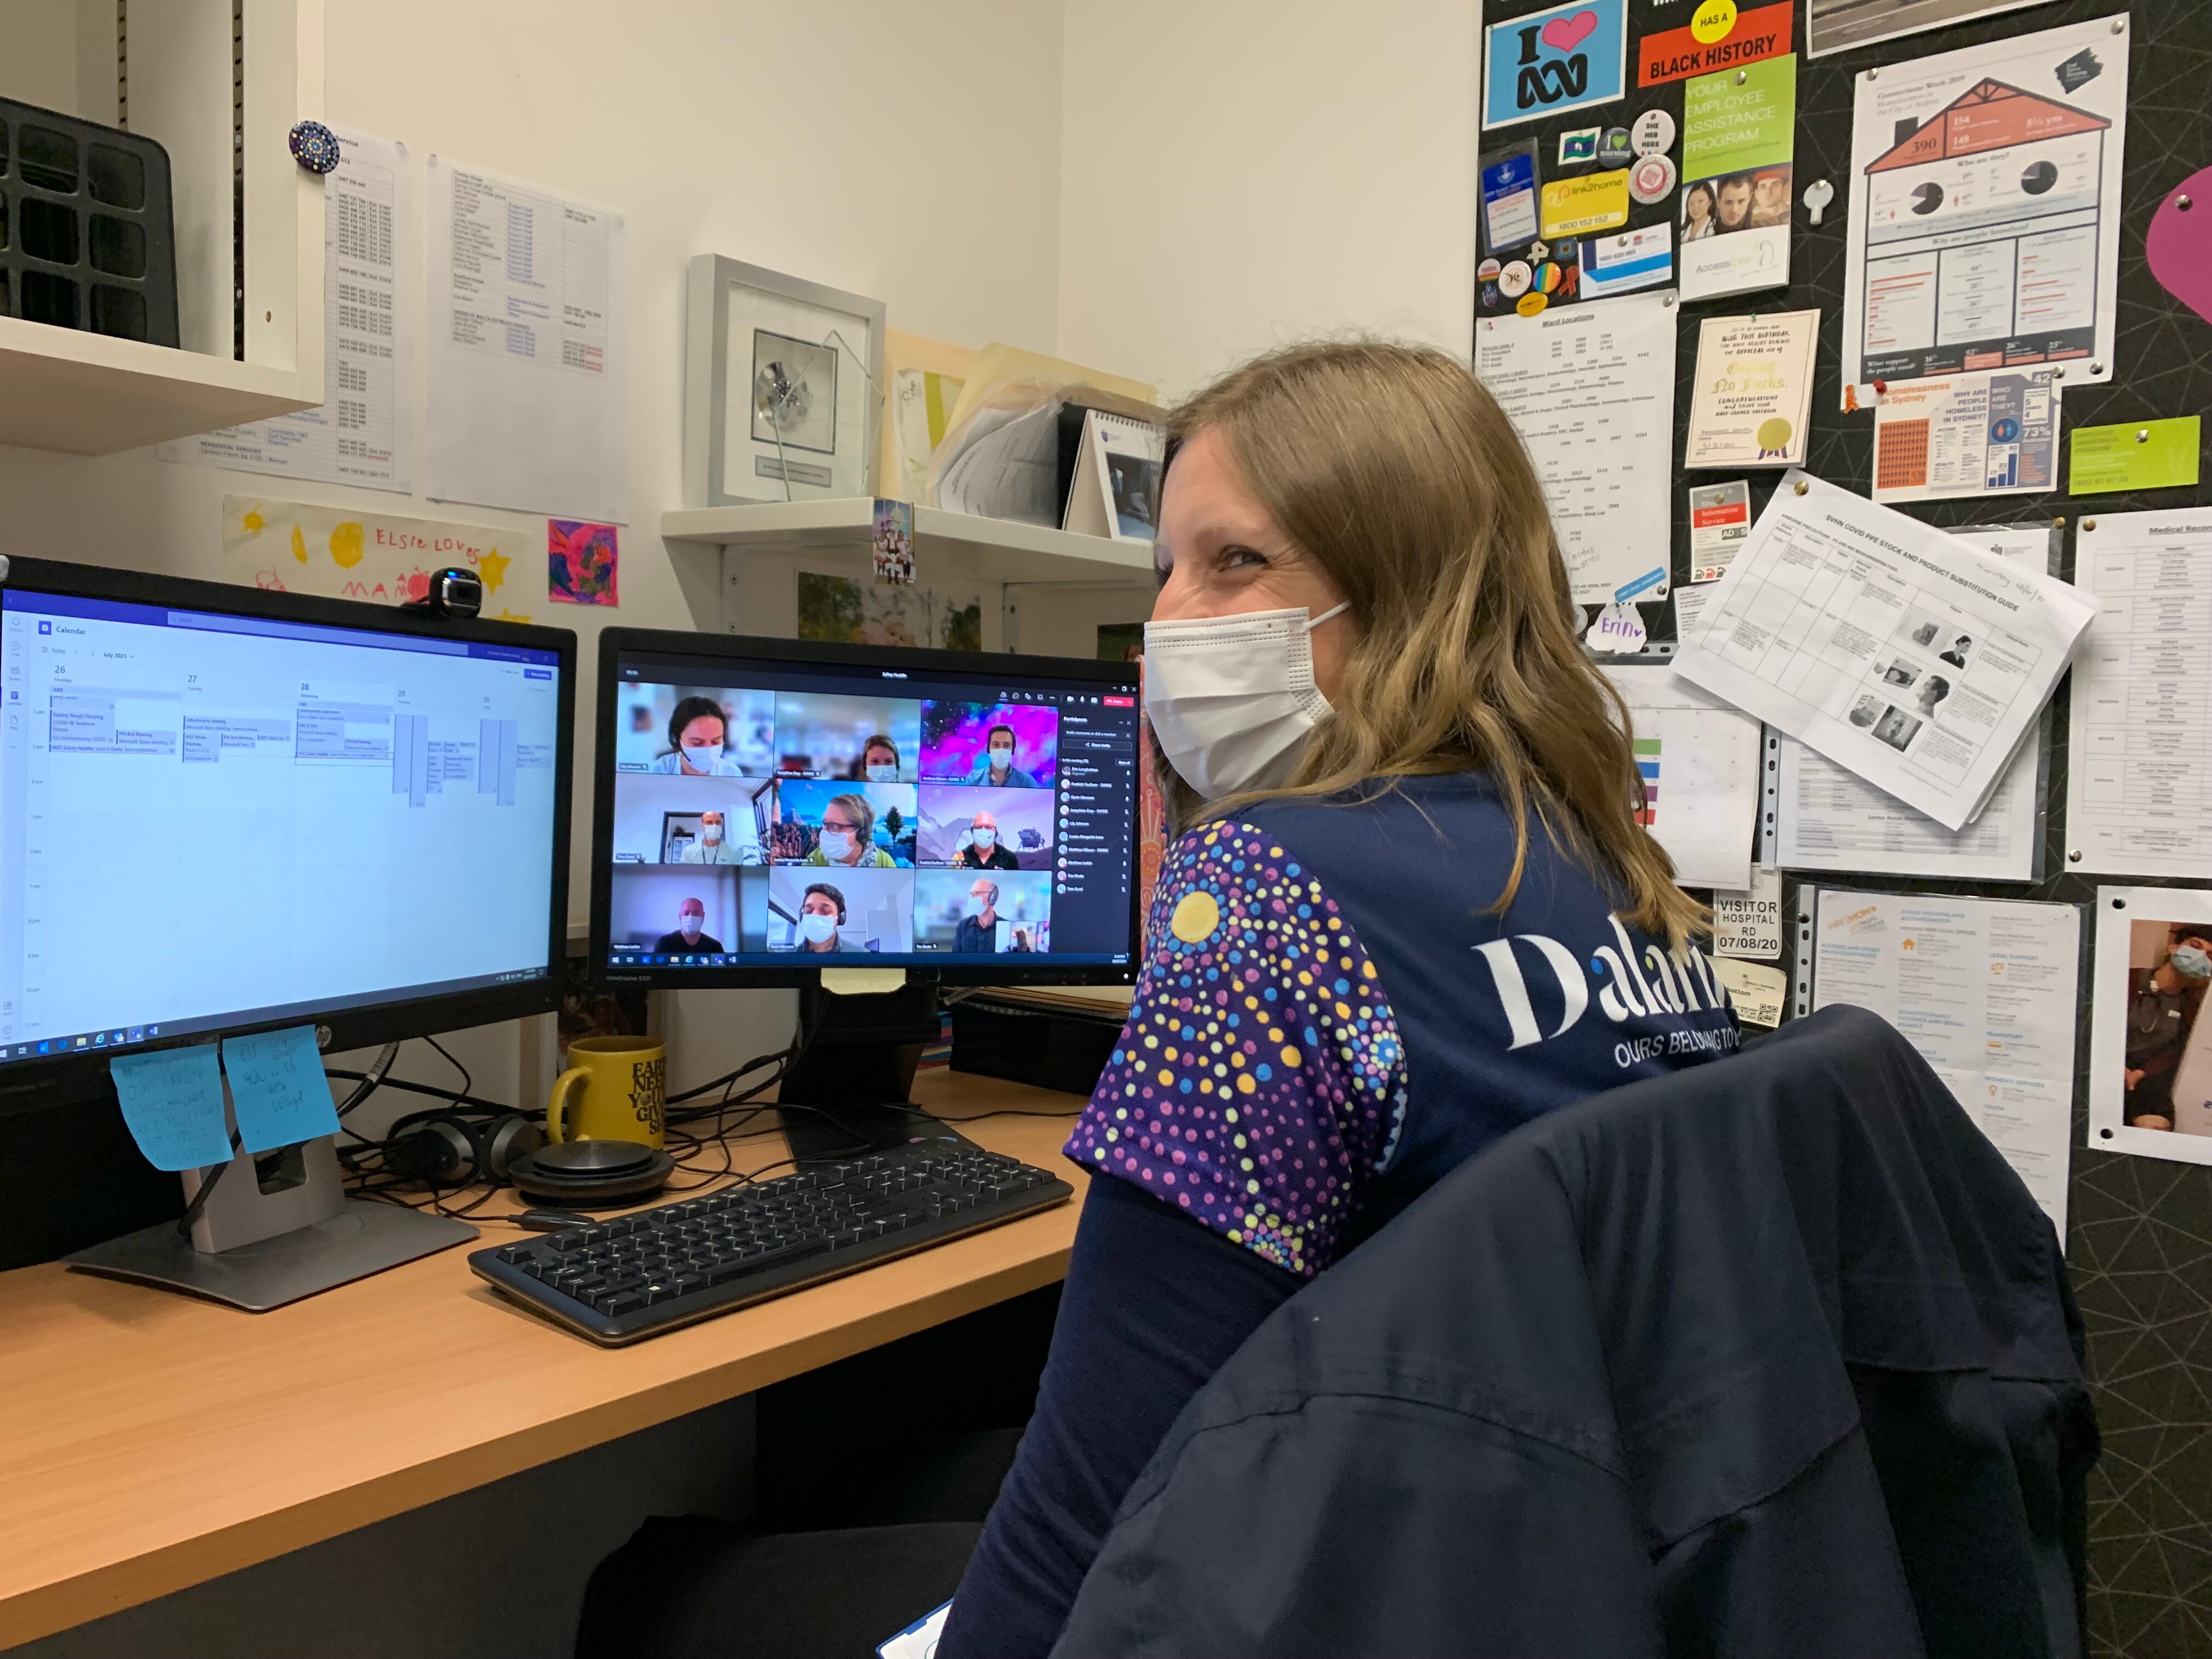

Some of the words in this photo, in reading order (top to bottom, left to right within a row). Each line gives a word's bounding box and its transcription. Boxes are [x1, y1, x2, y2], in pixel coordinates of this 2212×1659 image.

[1700, 14, 1719, 27] HAS
[1721, 13, 1728, 22] A
[1517, 25, 1542, 65] I
[1650, 51, 1701, 79] BLACK
[1706, 33, 1776, 66] HISTORY
[1686, 80, 1727, 99] YOUR
[1877, 86, 1924, 99] Connections
[1926, 80, 1946, 88] Week
[1948, 75, 1965, 84] 2019
[1685, 89, 1764, 119] EMPLOYEE
[1684, 105, 1776, 136] ASSISTANCE
[1953, 115, 1970, 126] 154
[2045, 115, 2063, 125] yrs
[1606, 134, 1611, 149] I
[1684, 127, 1759, 155] PROGRAM
[1911, 138, 1937, 154] 390
[1953, 134, 1970, 145] 148
[1599, 148, 1632, 159] nursing
[1990, 151, 2010, 161] they?
[1572, 179, 1623, 195] link2home
[1559, 221, 1577, 230] 1800
[1579, 218, 1593, 227] 152
[1595, 215, 1608, 224] 152
[1932, 236, 1948, 245] Why
[1542, 318, 1561, 328] Ward
[1563, 314, 1594, 325] Locations
[2033, 373, 2051, 384] 42
[1885, 383, 1951, 396] omelessness
[1718, 394, 1778, 404] CONGRATULATIONS
[1892, 394, 1926, 405] Sydney
[1958, 397, 1987, 406] PEOPLE
[1945, 405, 1987, 415] HOMELESS
[1991, 402, 2016, 410] THEY?
[1953, 413, 1987, 422] SYDNEY?
[2023, 426, 2051, 437] 73%
[1702, 507, 1739, 517] Information
[1702, 518, 1725, 526] Service
[1802, 523, 1830, 539] PRECAUTIONS
[2149, 526, 2183, 535] Medical
[1825, 514, 1844, 527] SVHN
[1844, 523, 1865, 537] COVID
[1865, 533, 1880, 544] PPE
[1878, 539, 1903, 555] STOCK
[1902, 551, 1918, 562] AND
[1918, 558, 1951, 578] PRODUCT
[1949, 573, 1997, 602] SUBSTITUTION
[1997, 597, 2021, 612] GUIDE
[56, 626, 86, 635] Calendar
[1601, 614, 1634, 637] Erin
[54, 665, 66, 674] 26
[1720, 900, 1778, 913] VISITOR
[1723, 913, 1775, 924] HOSPITAL
[1742, 927, 1756, 936] RD
[1720, 937, 1778, 950] 07/08/20
[318, 1028, 330, 1045] hp
[1986, 1031, 2023, 1039] TRANSPORT
[1614, 1035, 1664, 1068] OURS
[1720, 1026, 1734, 1049] TO
[1984, 1075, 2015, 1085] WOMEN'S
[2016, 1080, 2045, 1088] SERVICES
